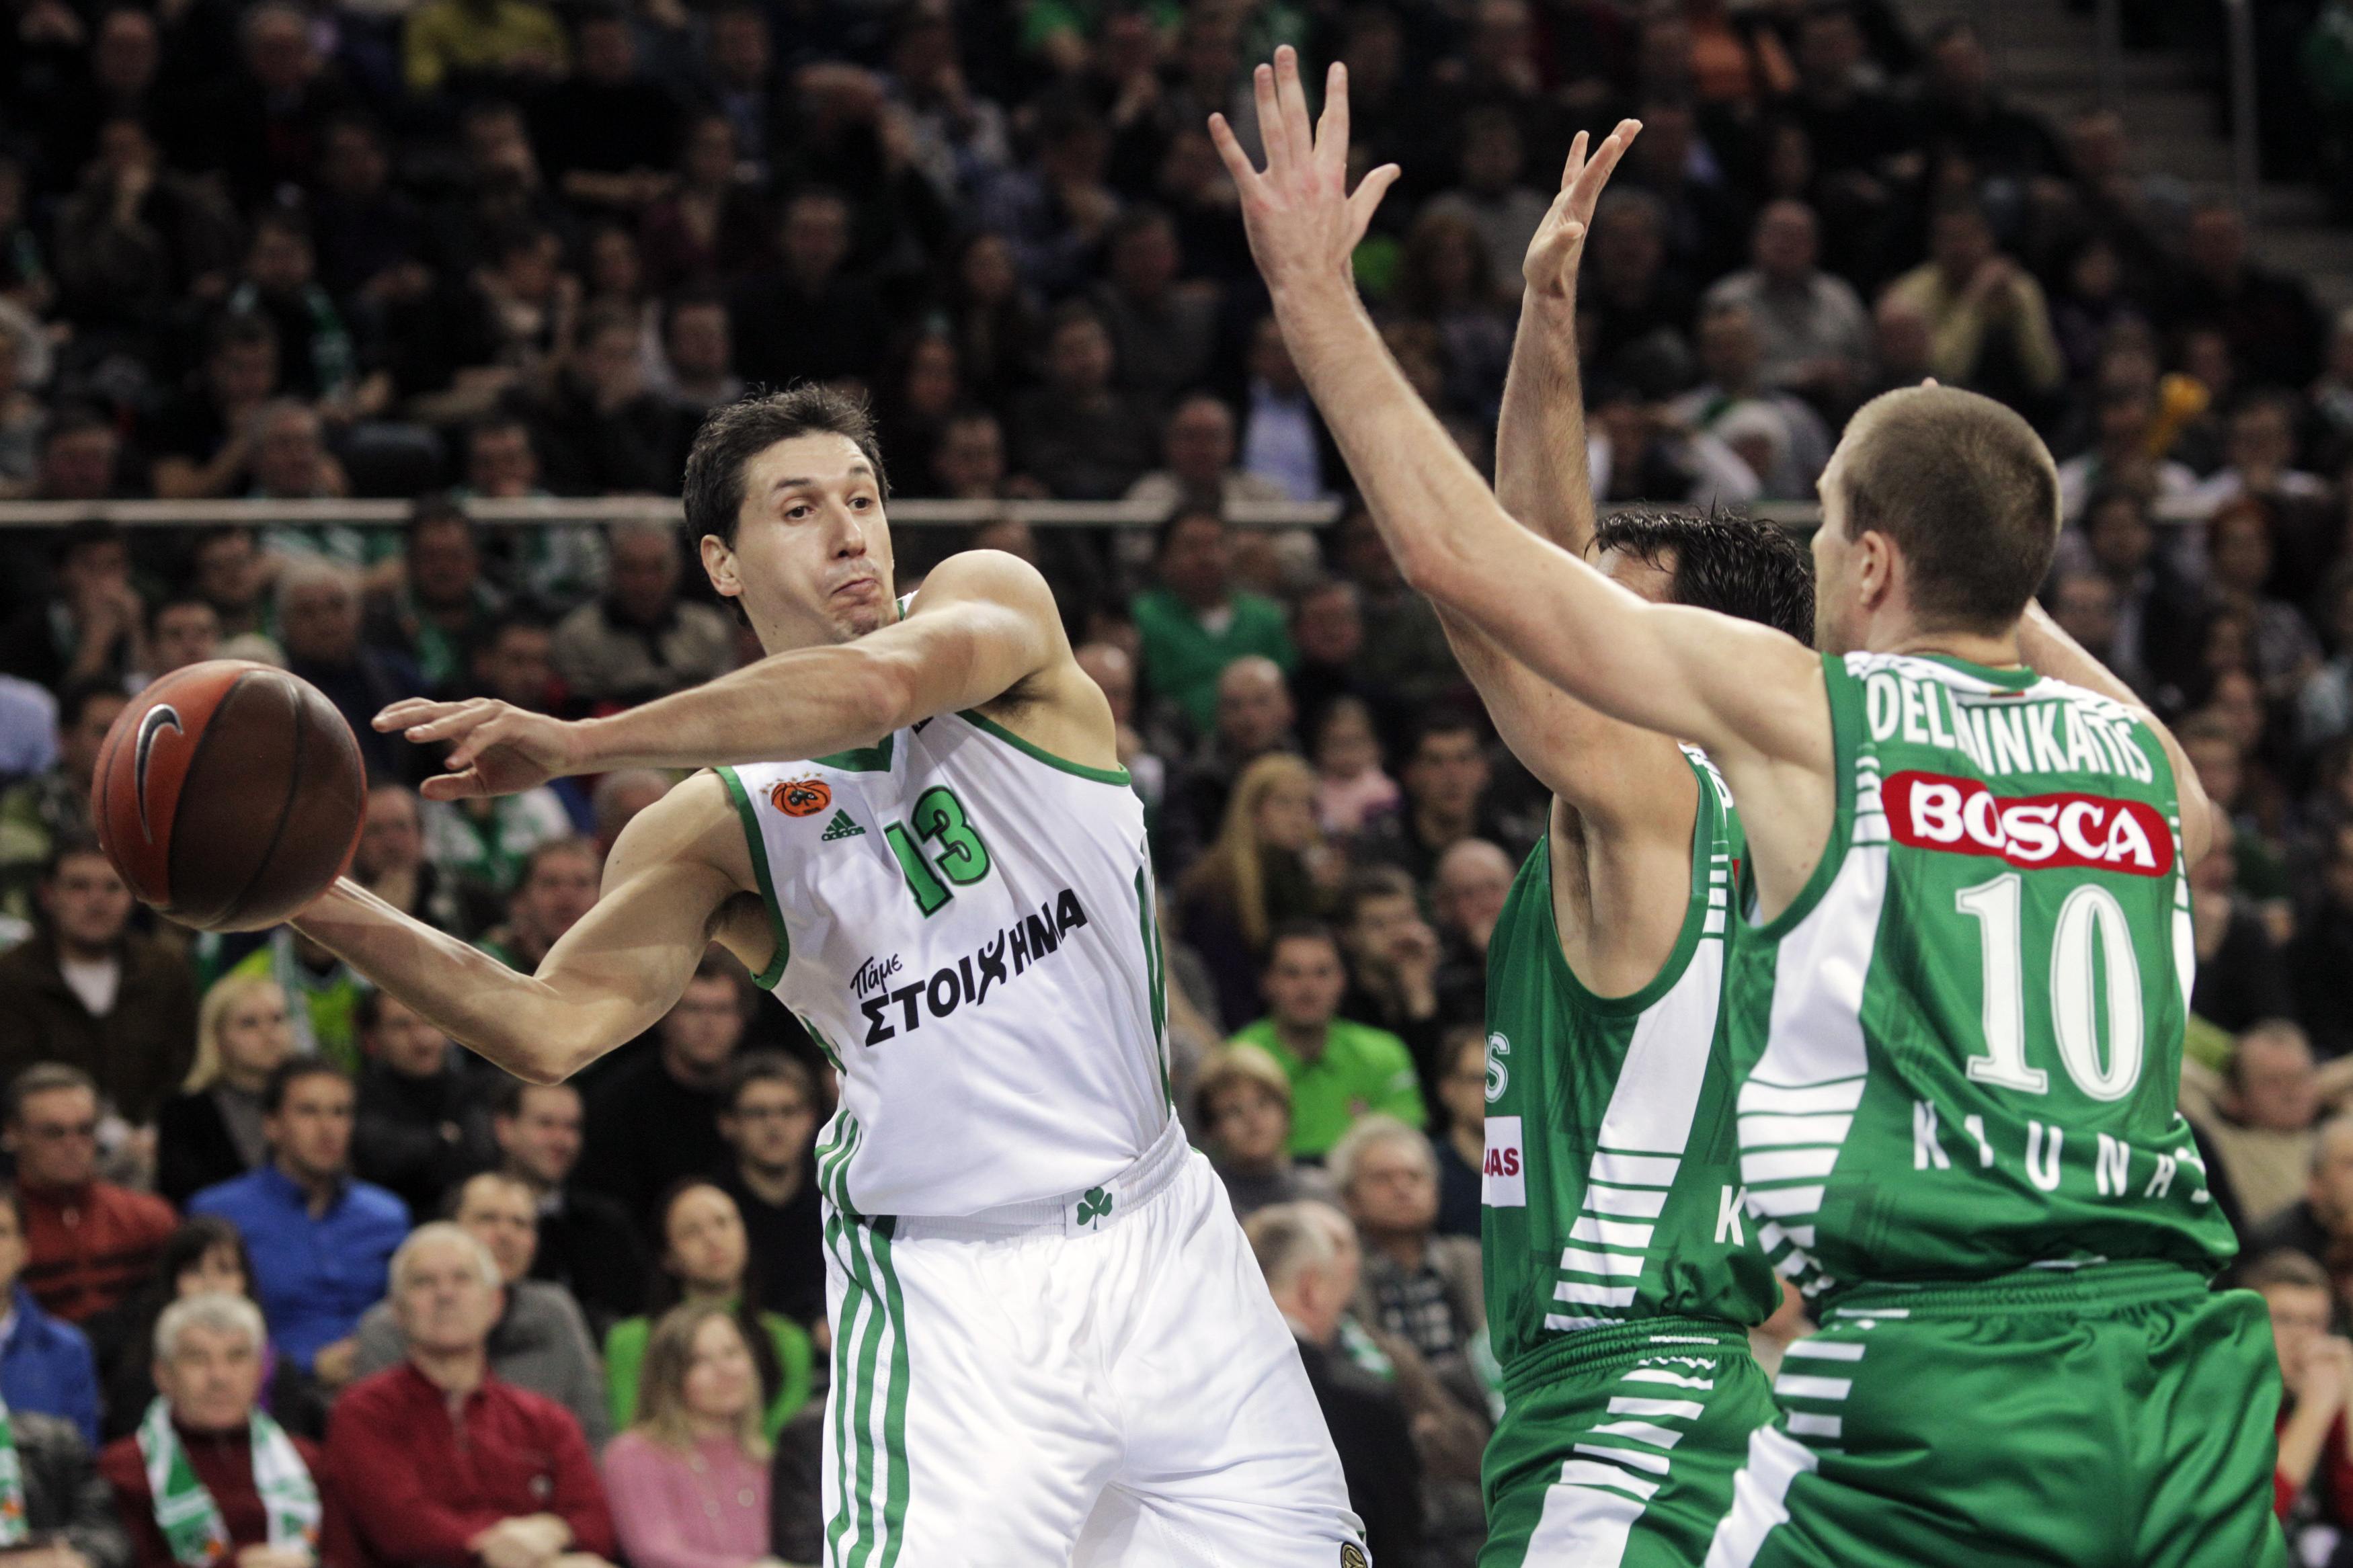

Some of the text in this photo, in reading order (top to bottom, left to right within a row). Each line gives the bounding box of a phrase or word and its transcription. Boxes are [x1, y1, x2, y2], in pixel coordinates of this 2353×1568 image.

[822, 826, 866, 841] adidas
[884, 784, 991, 919] 13
[1909, 780, 2156, 868] BOSCA
[850, 953, 903, 999] Πάμε
[1955, 872, 2143, 1102] 10
[1484, 1031, 1511, 1104] S
